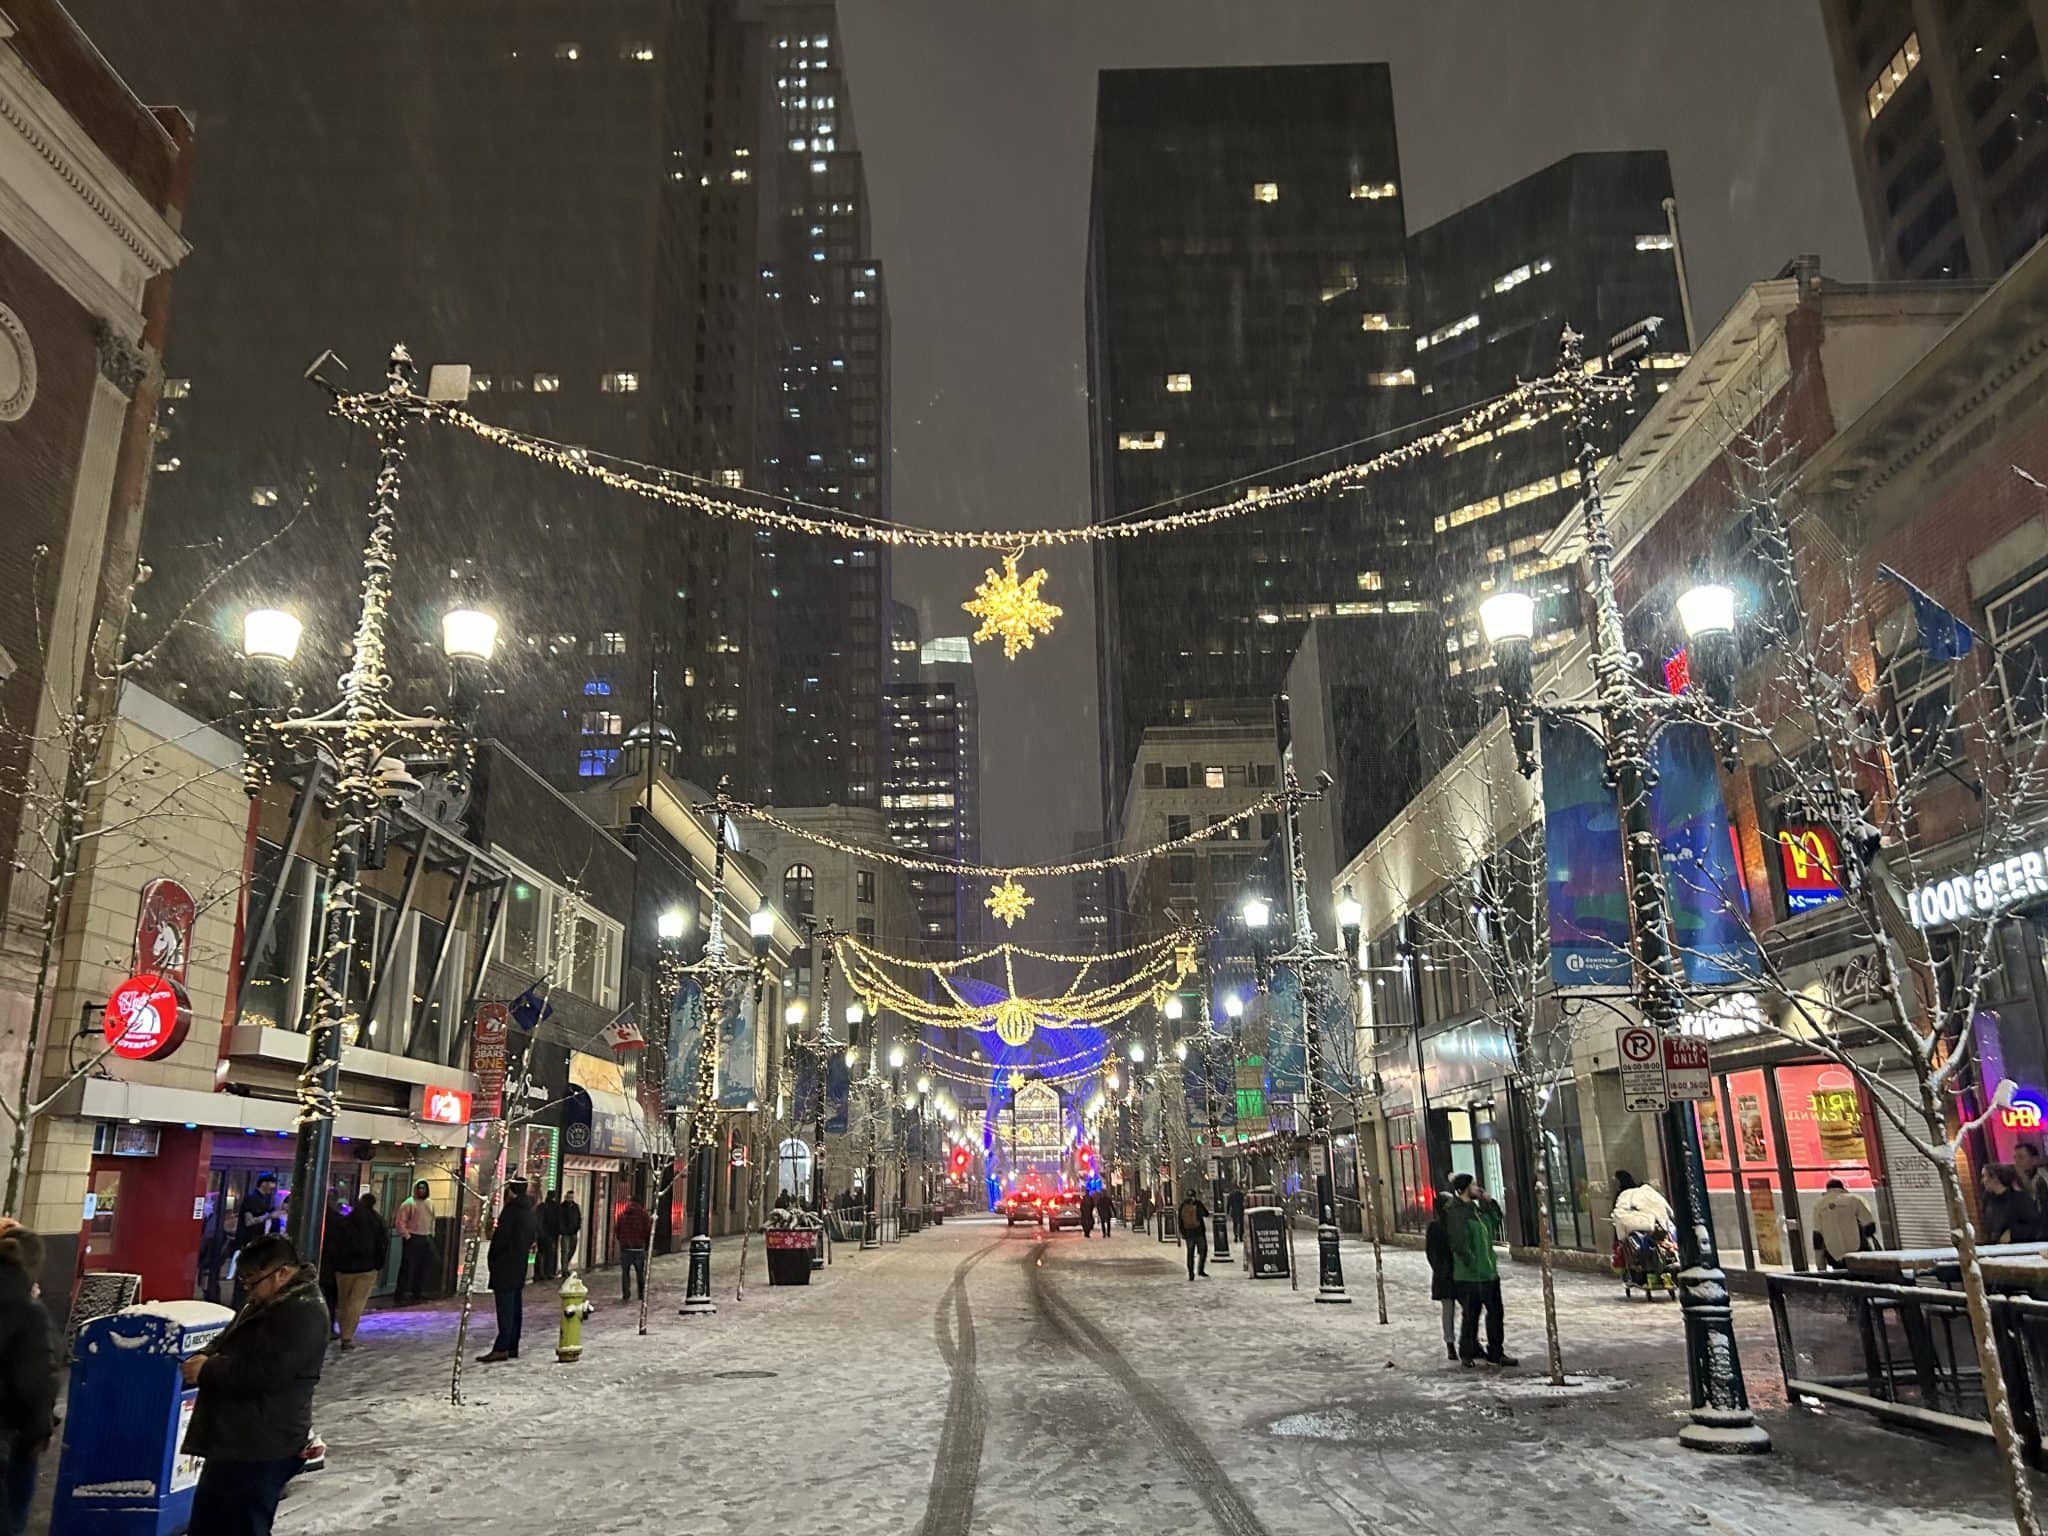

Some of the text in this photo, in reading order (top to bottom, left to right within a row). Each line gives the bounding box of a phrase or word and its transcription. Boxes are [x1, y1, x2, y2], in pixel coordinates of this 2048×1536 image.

[1973, 852, 2048, 911] BEER
[475, 1059, 503, 1069] ONE
[1672, 1053, 1699, 1064] ONLY
